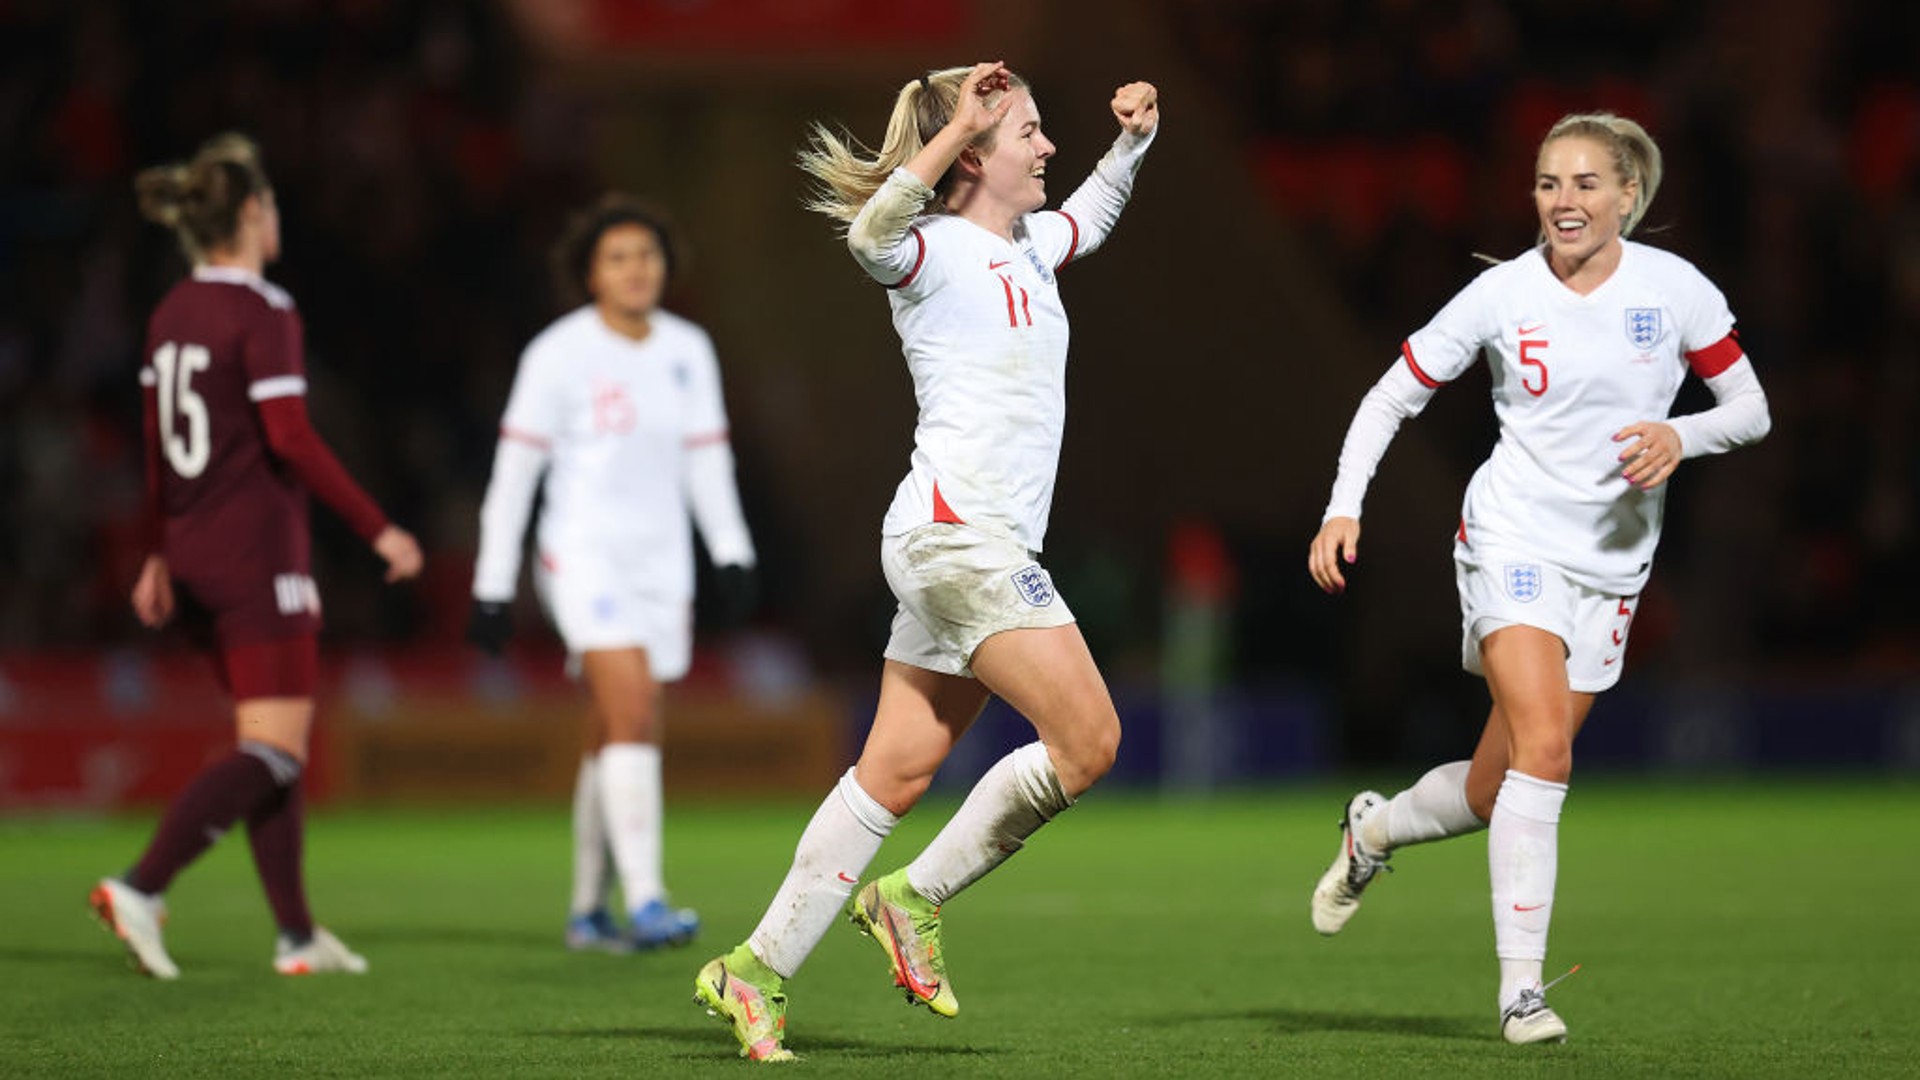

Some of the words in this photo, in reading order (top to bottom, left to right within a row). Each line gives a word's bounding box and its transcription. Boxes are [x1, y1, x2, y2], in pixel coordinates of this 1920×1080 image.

[998, 273, 1033, 328] 11
[1519, 339, 1548, 397] 5
[153, 340, 211, 479] 15
[1612, 599, 1634, 646] 5
